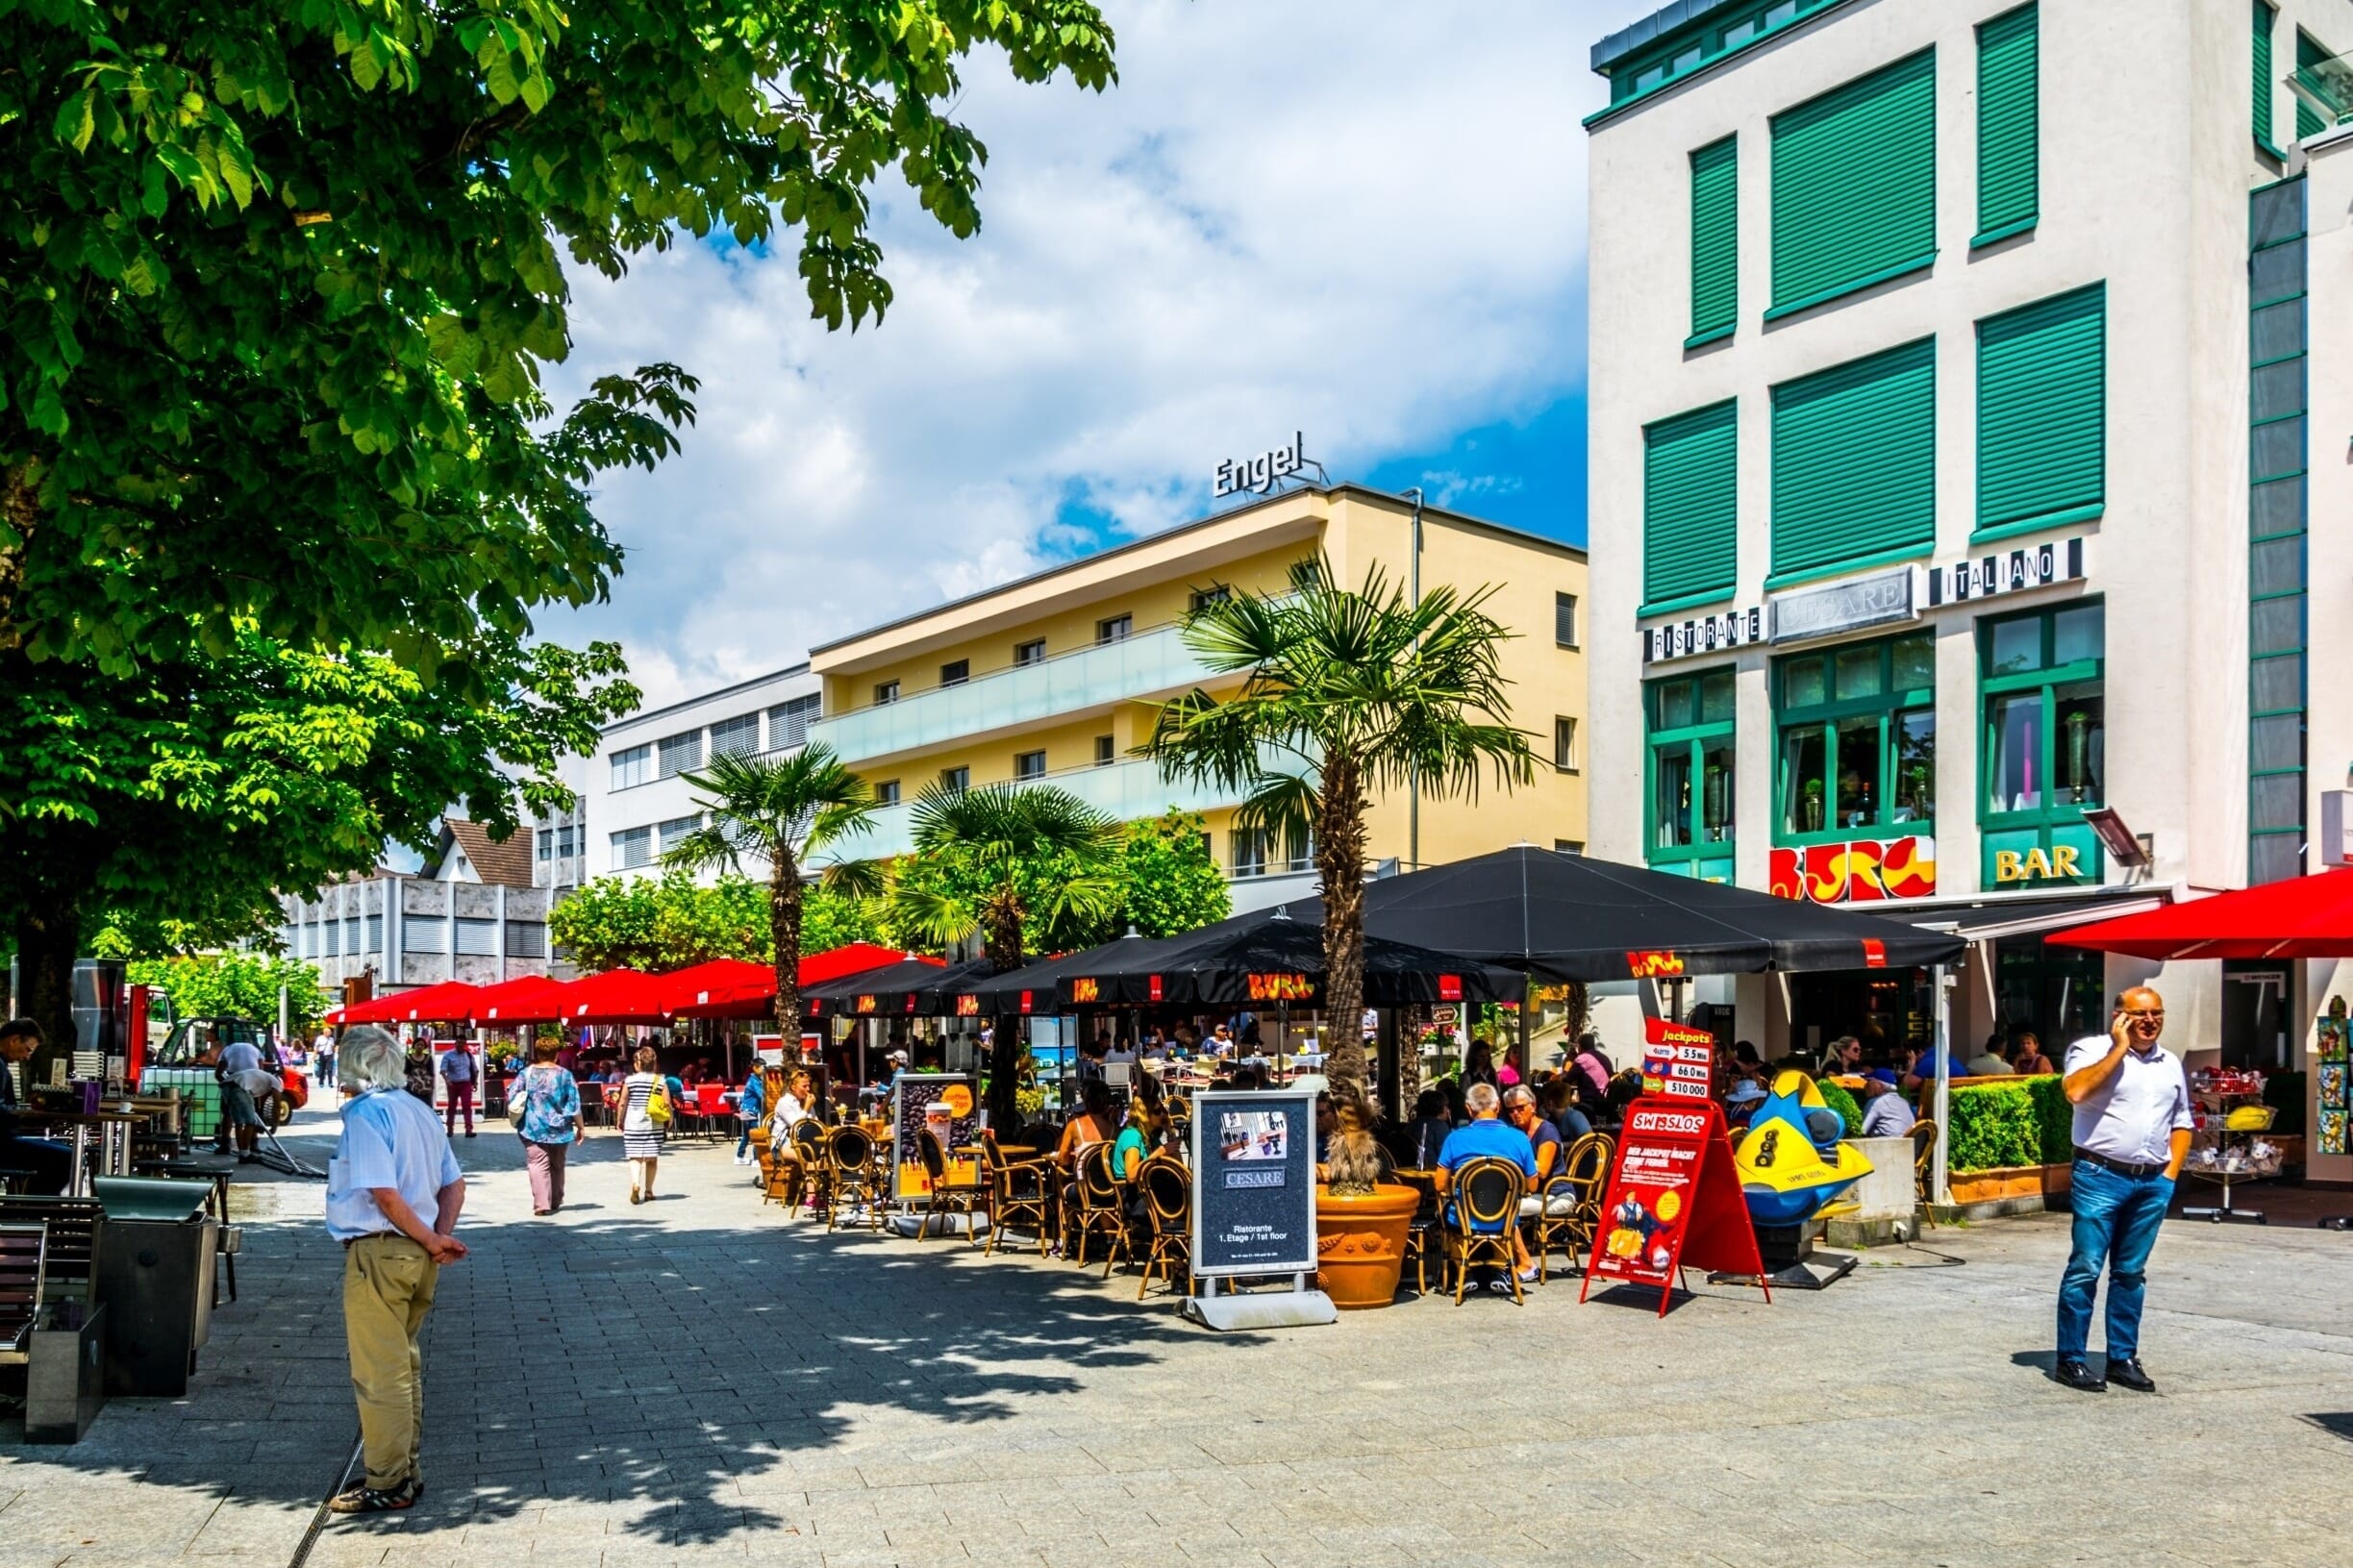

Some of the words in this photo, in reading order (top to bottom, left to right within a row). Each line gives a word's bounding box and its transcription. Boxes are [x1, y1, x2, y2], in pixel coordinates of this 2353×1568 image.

[1213, 431, 1302, 497] Engel
[1654, 610, 1760, 655] RISTORANTE
[1782, 579, 1900, 628] CESARE
[1946, 551, 2054, 596] ITALIANO
[1995, 845, 2083, 883] BAR
[1663, 1030, 1710, 1045] Jackpots
[1635, 1113, 1703, 1132] SWISSLOS
[1227, 1171, 1283, 1185] CESARE
[1234, 1225, 1272, 1233] Ristorante
[1227, 1233, 1249, 1243] Etage
